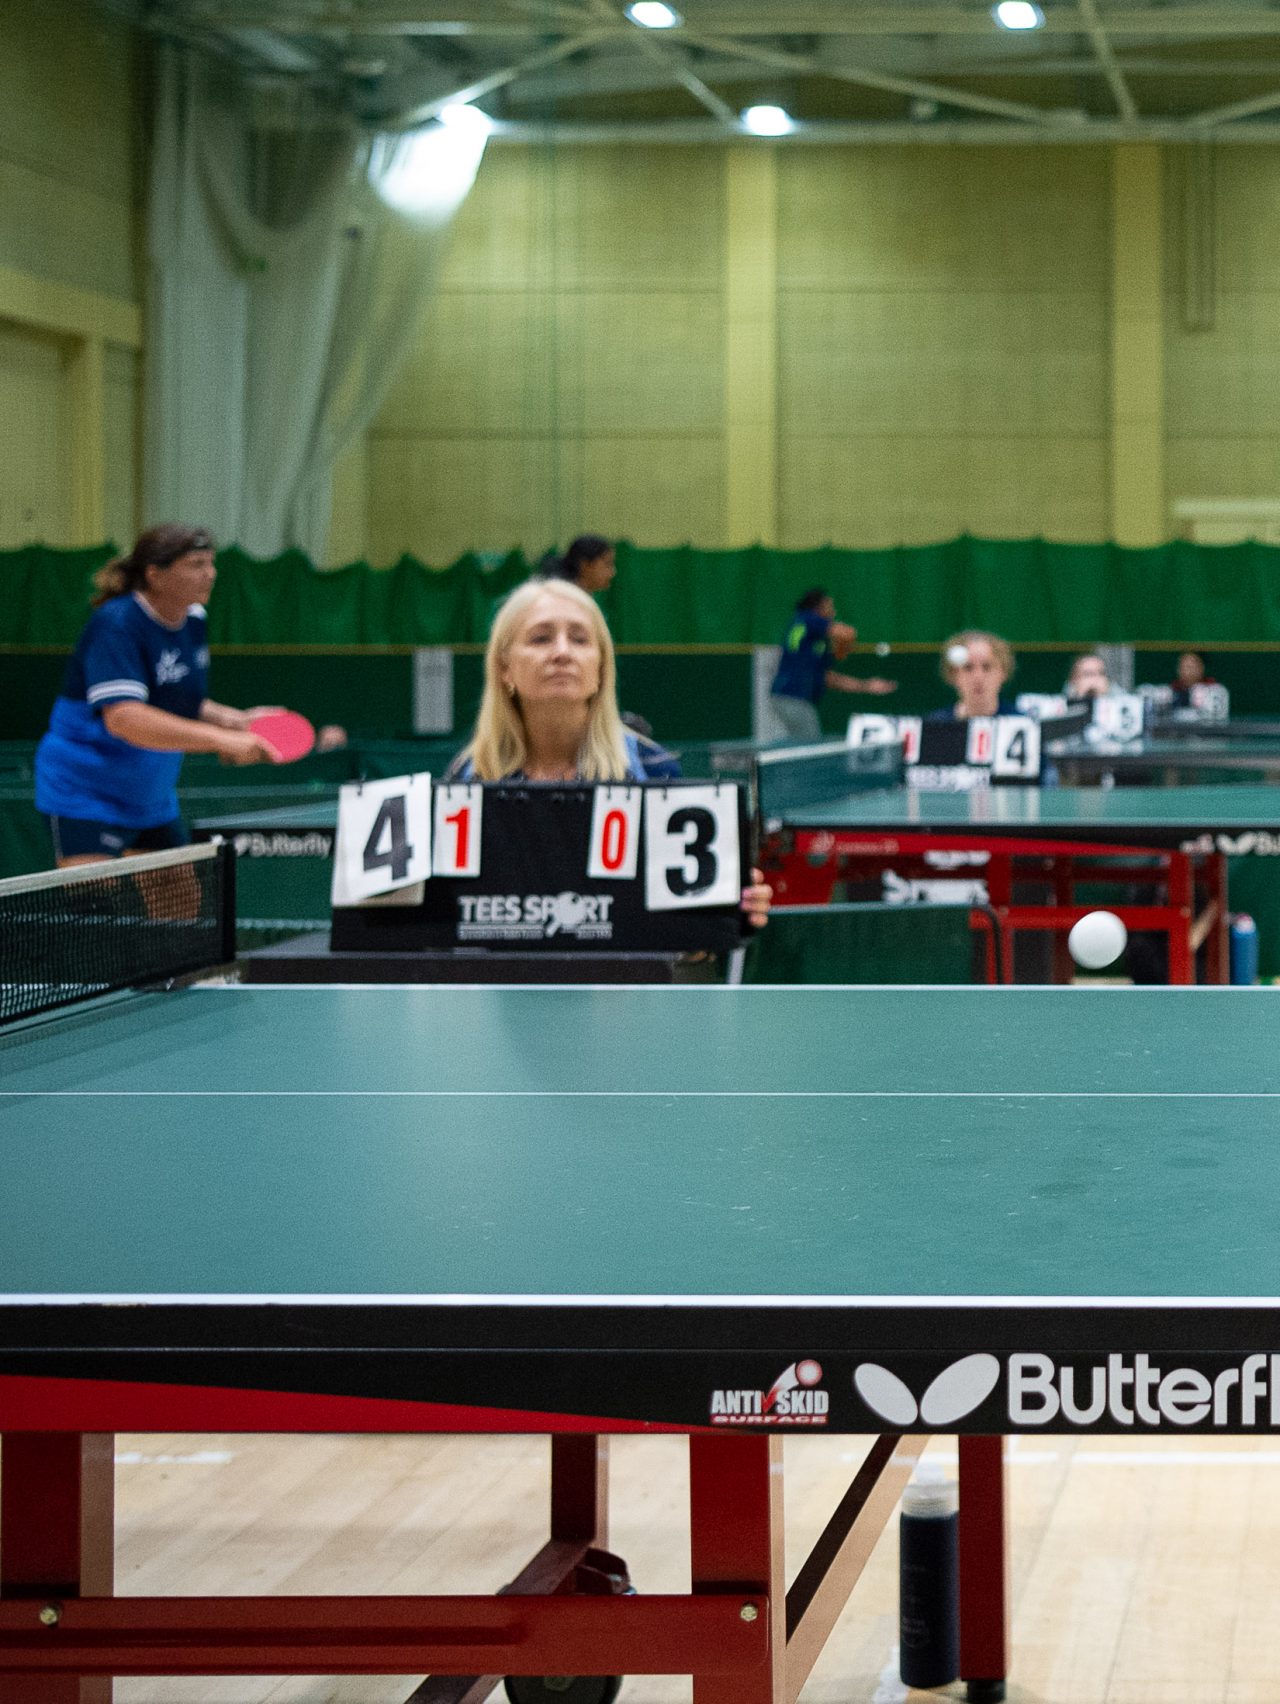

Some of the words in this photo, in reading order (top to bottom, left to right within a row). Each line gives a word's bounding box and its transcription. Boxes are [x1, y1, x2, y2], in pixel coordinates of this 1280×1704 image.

[1006, 729, 1027, 767] 4
[250, 832, 332, 858] Butterfly
[363, 795, 414, 881] 4
[446, 807, 470, 870] 1
[602, 809, 628, 872] 0
[665, 807, 719, 897] 3
[458, 895, 521, 922] TEES
[711, 1390, 763, 1414] ANTI
[776, 1390, 830, 1414] SKID
[711, 1415, 828, 1425] SURFACE
